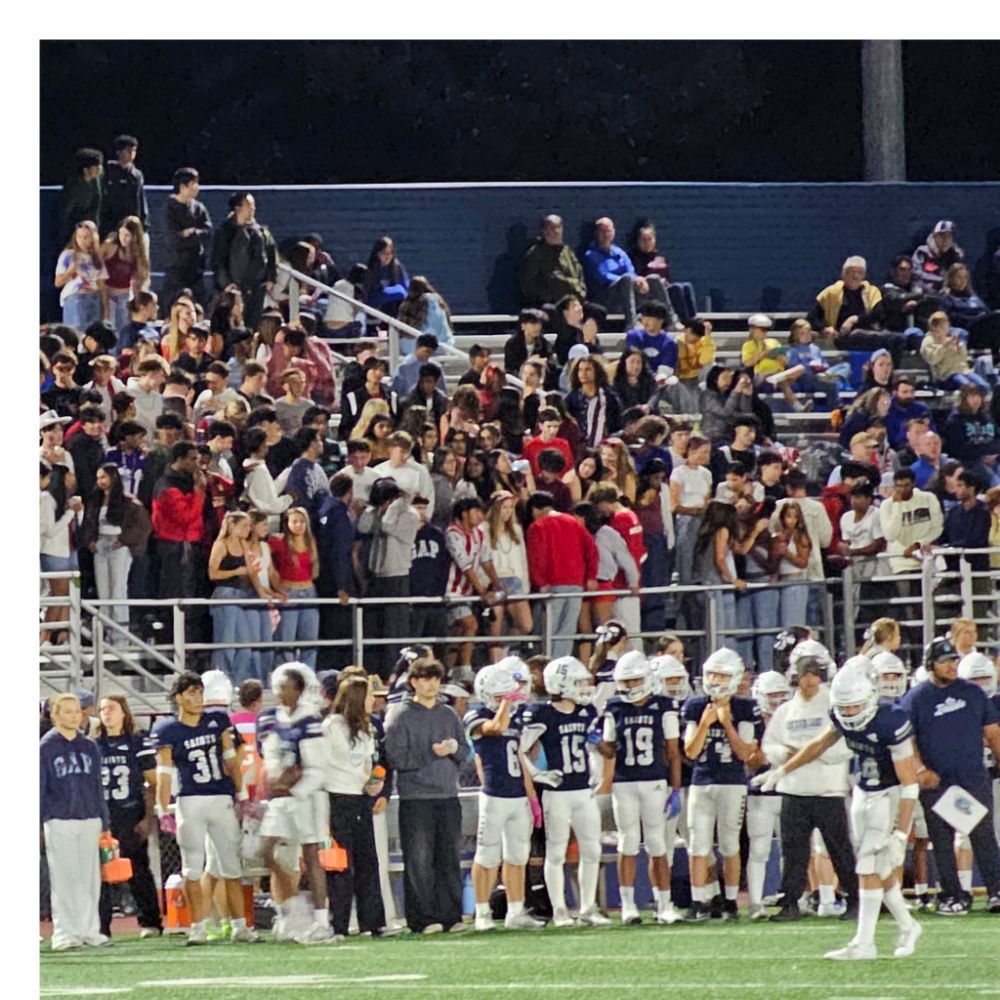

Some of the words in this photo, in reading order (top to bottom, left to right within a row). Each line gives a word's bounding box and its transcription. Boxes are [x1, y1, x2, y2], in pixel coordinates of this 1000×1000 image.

[183, 734, 217, 750] SAINTS
[560, 734, 586, 774] 15
[624, 727, 654, 766] 19
[53, 752, 92, 779] GAP
[188, 745, 223, 784] 31
